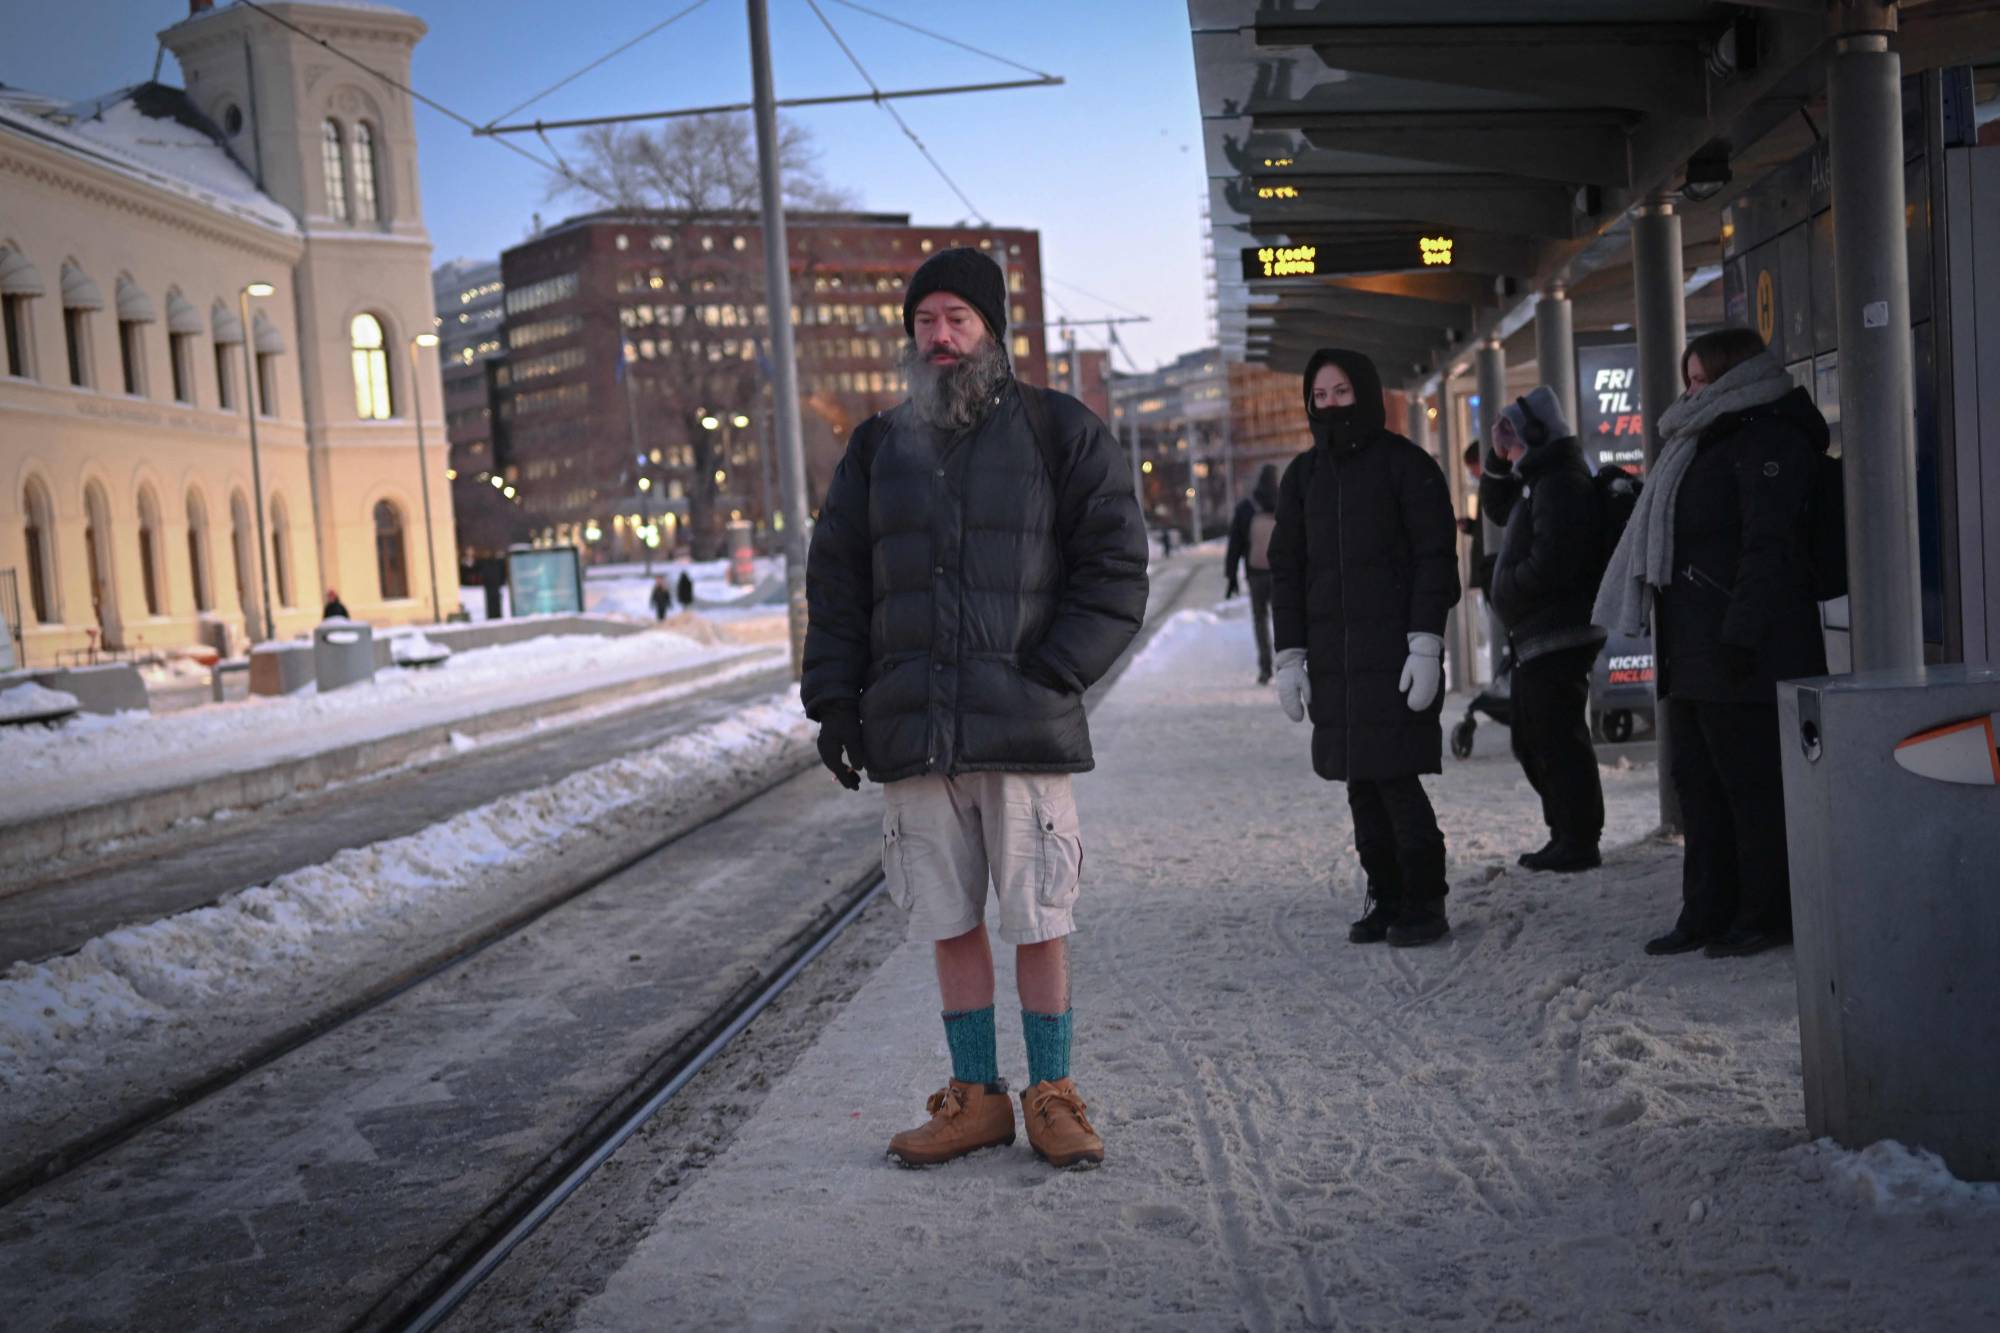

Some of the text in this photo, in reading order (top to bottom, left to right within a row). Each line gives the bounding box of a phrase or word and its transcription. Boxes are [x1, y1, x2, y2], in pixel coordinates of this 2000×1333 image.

[1594, 368, 1634, 391] FRI
[1598, 392, 1632, 414] TIL
[1600, 450, 1613, 463] Bli
